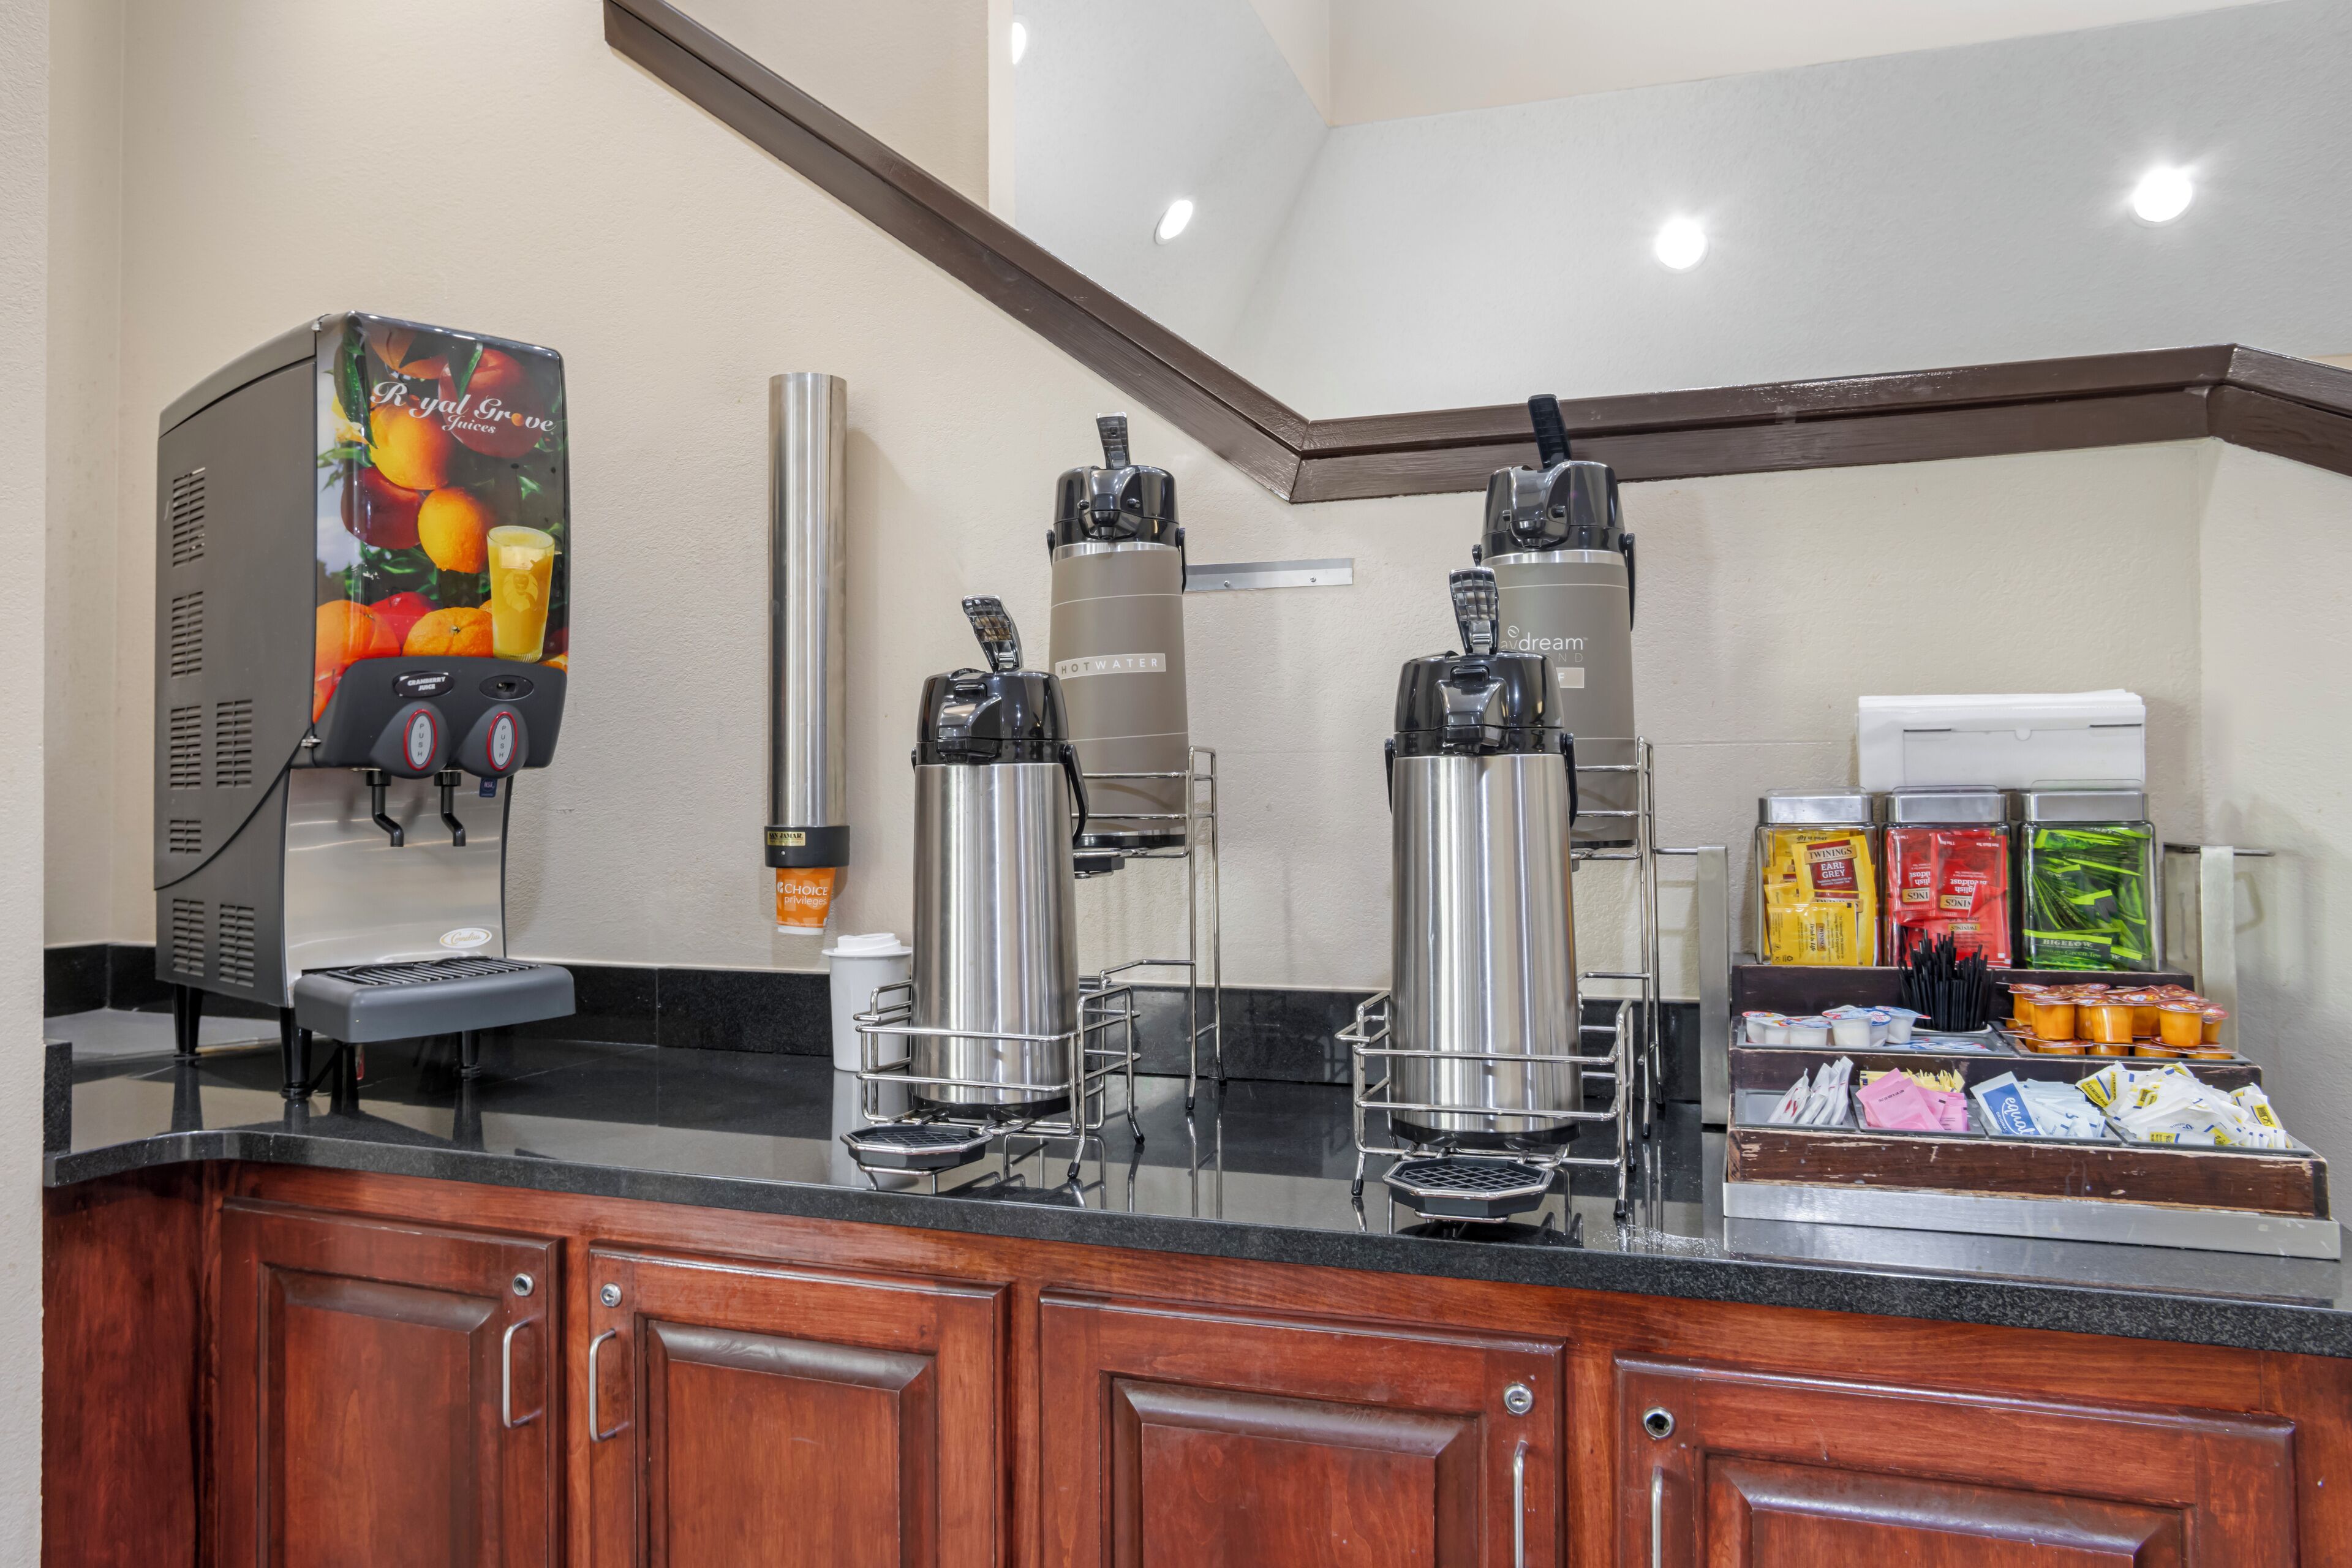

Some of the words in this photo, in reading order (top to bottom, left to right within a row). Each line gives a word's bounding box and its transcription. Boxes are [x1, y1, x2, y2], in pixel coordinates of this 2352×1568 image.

[370, 381, 472, 419] Royal
[473, 398, 556, 432] Grove
[442, 415, 497, 434] Juices
[407, 676, 446, 687] CRANBERRY
[1808, 847, 1852, 859] TWININGS
[1821, 862, 1845, 870] EARL
[1822, 869, 1845, 878] GREY
[785, 883, 828, 896] CHOICE
[784, 896, 827, 908] privileges
[1907, 892, 1928, 900] INGS
[2043, 939, 2092, 948] BIGELOW
[2005, 1097, 2035, 1135] equal
